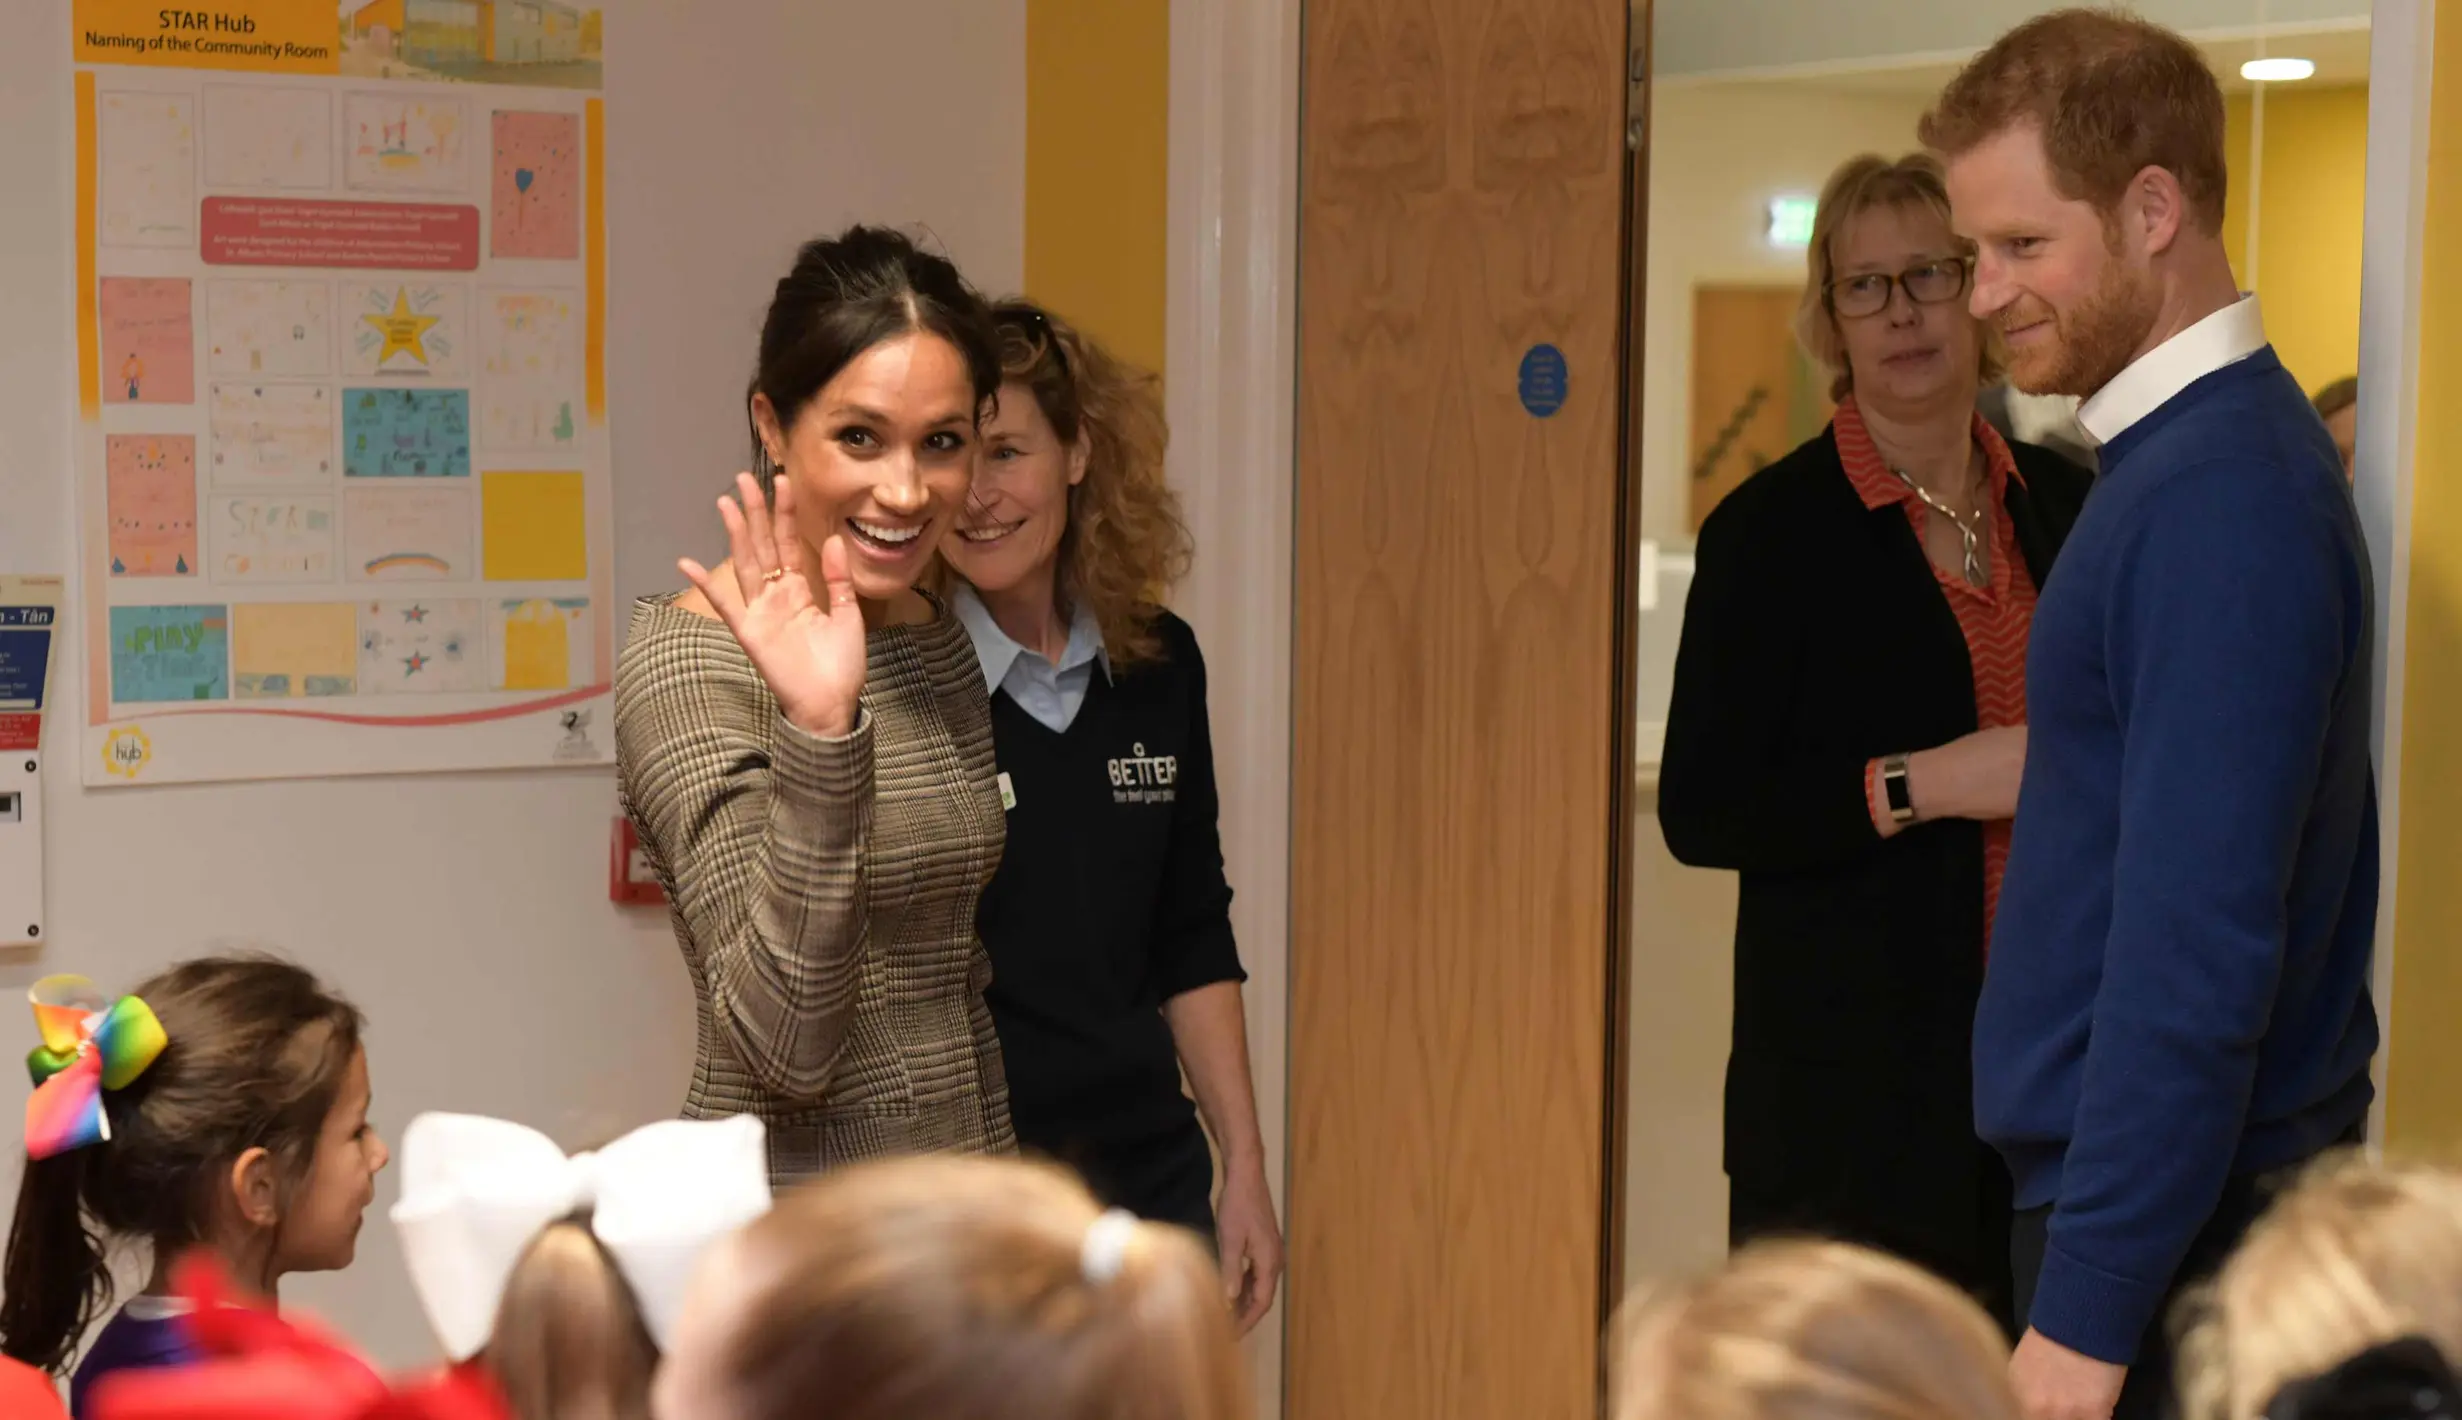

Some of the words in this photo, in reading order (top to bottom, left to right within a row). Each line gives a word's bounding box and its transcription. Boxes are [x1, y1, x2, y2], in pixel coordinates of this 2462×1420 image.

[159, 10, 209, 31] STAR
[214, 13, 256, 34] Hub
[85, 31, 145, 53] Naming
[149, 34, 164, 50] of
[167, 36, 192, 52] the
[194, 38, 281, 61] Community
[284, 42, 329, 59] Room
[20, 607, 49, 624] Tân
[1107, 755, 1177, 787] BETTER
